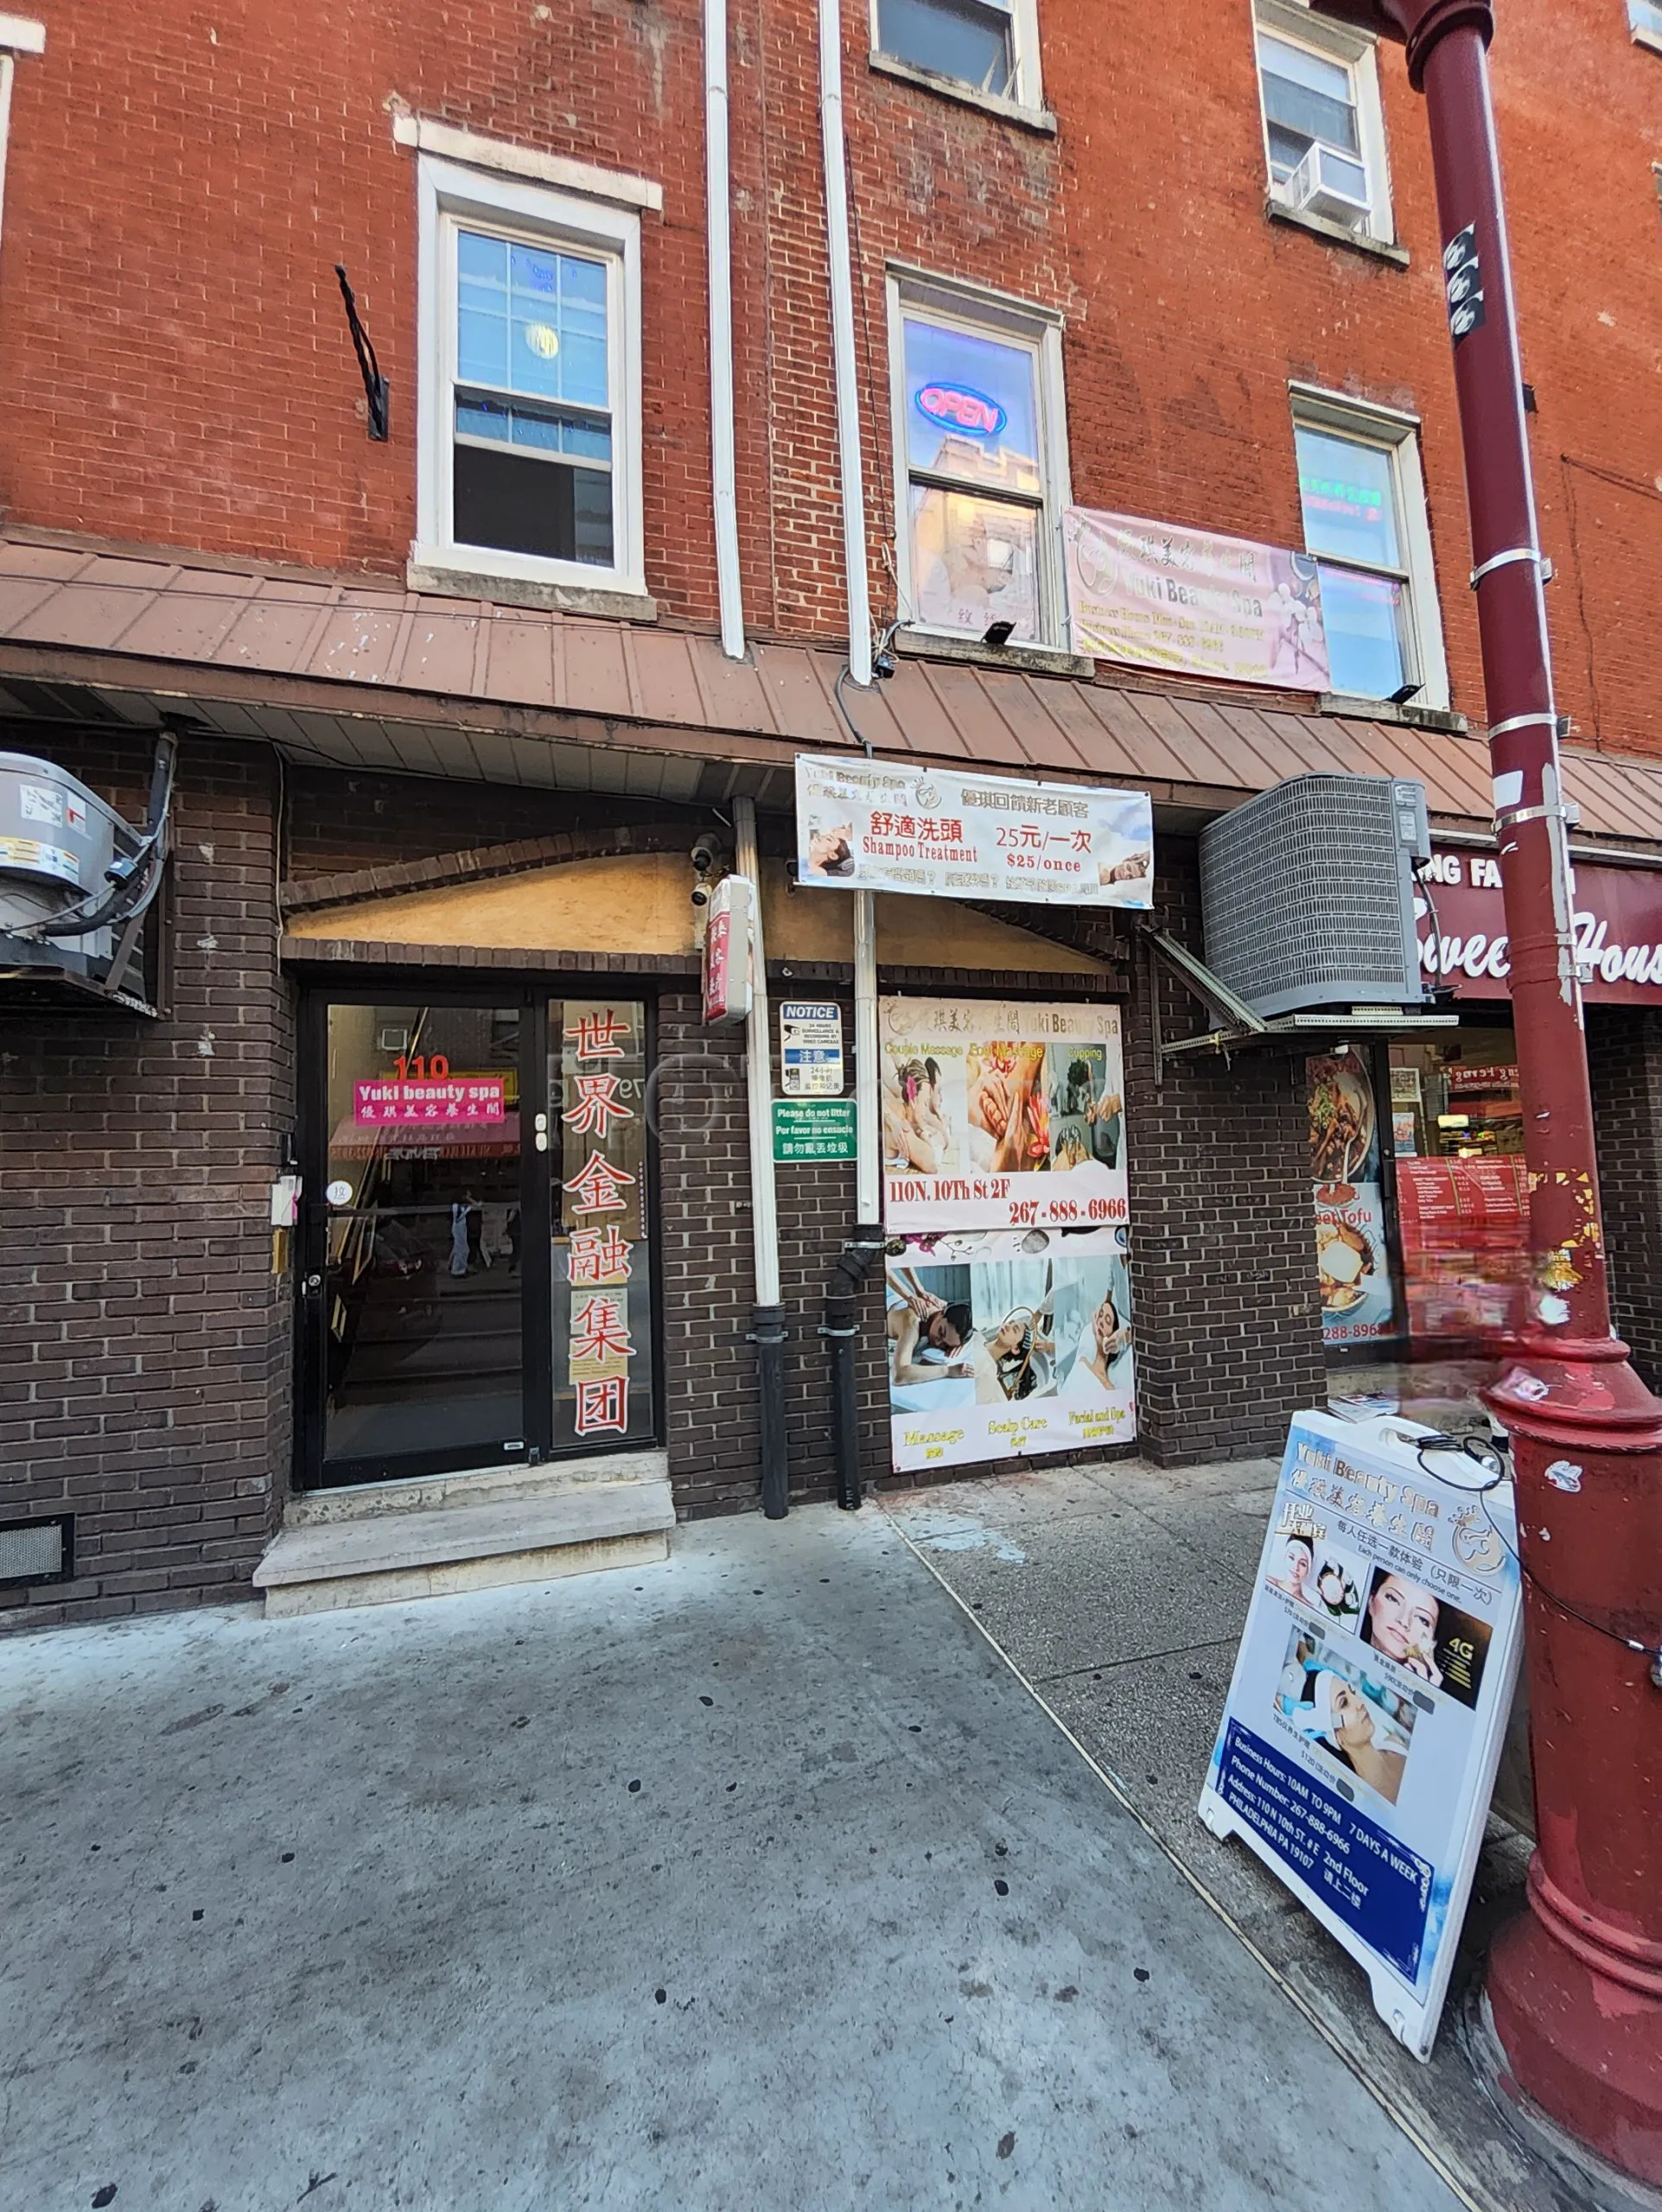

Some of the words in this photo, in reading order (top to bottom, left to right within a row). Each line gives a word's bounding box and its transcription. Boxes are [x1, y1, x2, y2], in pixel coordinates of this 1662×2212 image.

[920, 388, 998, 432] OPEN
[1232, 589, 1263, 618] Spa
[870, 810, 964, 843] 舒適洗頭
[863, 836, 915, 862] Shampoo
[919, 842, 978, 863] Treatment
[996, 824, 1092, 854] 25元/一次
[1007, 852, 1081, 872] $25/once
[786, 1006, 835, 1018] NOTICE
[1097, 1015, 1118, 1038] Spa
[799, 1049, 826, 1063] 注意
[920, 1044, 963, 1056] Massage
[1067, 1046, 1103, 1060] Cupping
[393, 1055, 449, 1080] 110
[360, 1086, 399, 1101] Yuki
[404, 1084, 465, 1103] beauty
[468, 1086, 500, 1101] spa
[777, 1108, 804, 1118] Please
[775, 1126, 790, 1135] Por
[791, 1125, 811, 1134] favor
[973, 1179, 988, 1200] St
[990, 1178, 1010, 1199] 2F
[562, 1008, 638, 1438] 世界金融集团
[1340, 1208, 1372, 1224] Tofu
[903, 1428, 965, 1447] Massage
[1297, 1442, 1332, 1471] Yuki
[1333, 1457, 1399, 1503] Beauty
[1400, 1485, 1440, 1519] Spa
[1358, 1545, 1372, 1556] Each
[1372, 1552, 1394, 1569] person
[1394, 1564, 1406, 1573] can
[1406, 1571, 1421, 1584] only
[1422, 1578, 1445, 1595] choose
[1446, 1592, 1462, 1604] one.
[1449, 1637, 1474, 1660] 4G
[1231, 1755, 1256, 1780] Phone
[1255, 1773, 1291, 1808] Number:
[1290, 1800, 1351, 1855] 267-888-6966
[1234, 1736, 1263, 1764] Business
[1263, 1758, 1287, 1783] Hours:
[1288, 1775, 1310, 1800] 10AM
[1311, 1792, 1323, 1810] TO
[1323, 1802, 1342, 1825] 9PM
[1349, 1821, 1357, 1834] 7
[1356, 1827, 1381, 1855] DAYS
[1380, 1848, 1389, 1862] A
[1390, 1853, 1418, 1885] WEEK
[1227, 1774, 1257, 1804] Address:
[1257, 1796, 1270, 1813] 110
[1270, 1807, 1277, 1820] N
[1278, 1812, 1295, 1835] 10th
[1295, 1826, 1306, 1846] ST.
[1323, 1850, 1343, 1875] 2nd
[1343, 1866, 1369, 1897] Floor
[1228, 1792, 1278, 1841] PHILADELPHIA
[1278, 1834, 1289, 1851] PA
[1290, 1844, 1314, 1870] 19107
